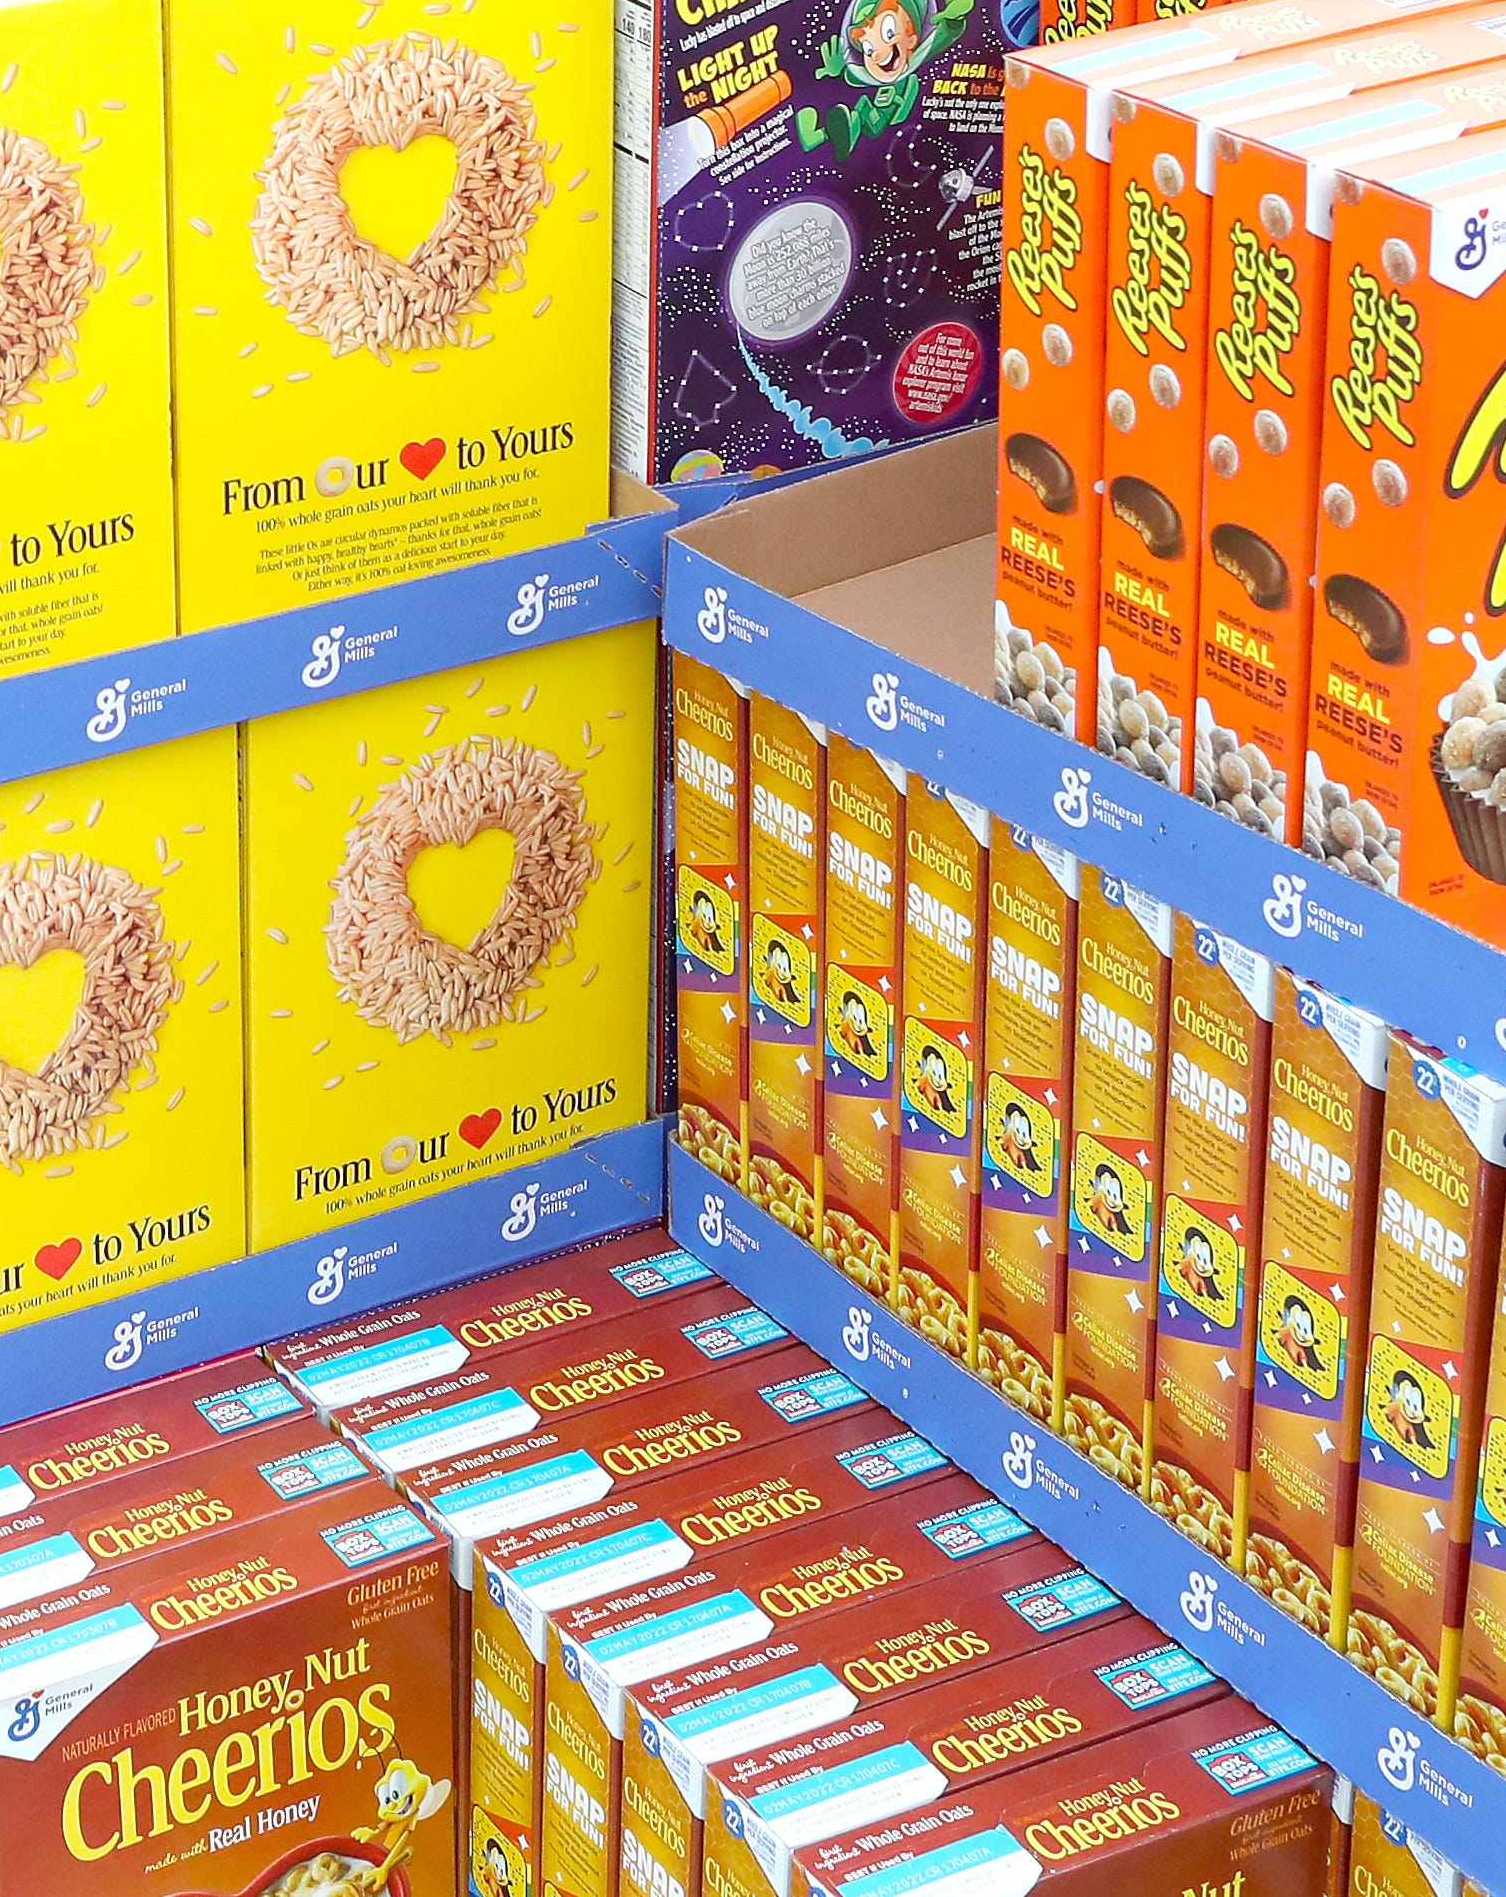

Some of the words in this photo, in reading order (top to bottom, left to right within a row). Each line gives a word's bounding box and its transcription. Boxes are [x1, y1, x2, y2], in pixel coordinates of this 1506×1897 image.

[676, 39, 746, 92] LIGHT
[751, 25, 779, 57] UP
[683, 89, 708, 108] the
[709, 53, 780, 103] NIGHT
[952, 63, 986, 78] NASA
[933, 80, 968, 95] BACK
[716, 147, 729, 161] this
[730, 139, 744, 152] box
[744, 131, 759, 144] into
[766, 105, 794, 130] magical
[1112, 179, 1152, 356] Reese's
[1147, 204, 1192, 351] Puffs
[1331, 264, 1380, 451] Reese's
[1372, 290, 1423, 446] Puffs
[222, 476, 305, 516] From
[456, 436, 485, 470] to
[491, 421, 575, 462] Yours
[9, 532, 41, 567] to
[45, 512, 136, 558] Yours
[19, 604, 48, 617] soluble
[51, 600, 70, 611] fiber
[72, 594, 89, 605] that
[20, 574, 54, 595] thank
[55, 567, 79, 589] you
[1327, 672, 1390, 725] REAL
[1330, 661, 1362, 683] made
[1364, 674, 1390, 698] with
[676, 687, 734, 742] Cheerios
[1315, 693, 1404, 754] REESE'S
[677, 738, 735, 789] SNAP
[1316, 719, 1356, 750] peanut
[1357, 736, 1399, 768] butter!
[677, 762, 701, 791] FOR
[703, 780, 734, 810] FUN!
[1092, 791, 1144, 828] General
[1092, 806, 1122, 832] Mills
[347, 1573, 404, 1608] Gluten
[405, 1560, 439, 1591] Free
[843, 1628, 991, 1696] Cheerios
[880, 1628, 926, 1656] Honey
[927, 1617, 959, 1640] Nut
[690, 1658, 734, 1685] Whole
[735, 1648, 767, 1674] Grain
[769, 1640, 800, 1662] Oats
[61, 1732, 121, 1763] NATURALLY
[122, 1708, 177, 1743] FLAVORED
[177, 1668, 295, 1737] Honey
[304, 1637, 372, 1692] Nut
[1191, 1747, 1207, 1760] NO
[1208, 1738, 1235, 1754] MORE
[1234, 1725, 1278, 1746] CLIPPING
[1212, 1755, 1248, 1776] BOX
[1248, 1736, 1288, 1755] SCAN
[61, 1683, 396, 1863] Cheerios
[1224, 1763, 1259, 1782] TOPS
[144, 1854, 180, 1875] made
[180, 1838, 209, 1864] with
[208, 1818, 252, 1852] Real
[256, 1794, 322, 1836] Honey
